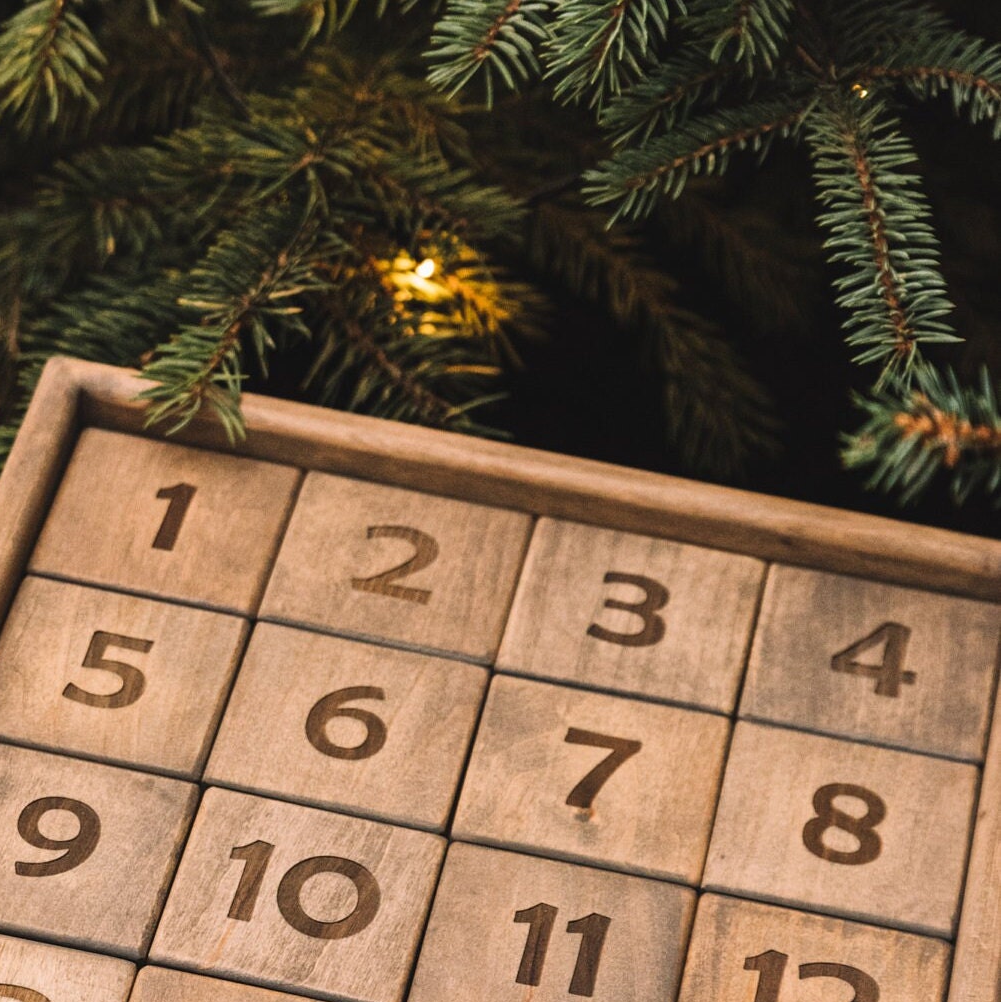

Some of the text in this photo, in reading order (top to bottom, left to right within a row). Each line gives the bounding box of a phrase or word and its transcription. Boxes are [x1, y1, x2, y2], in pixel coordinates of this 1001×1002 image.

[151, 482, 197, 551] 1
[351, 525, 440, 605] 2
[586, 571, 670, 647] 3
[62, 630, 155, 709] 5
[830, 621, 916, 698] 4
[305, 685, 388, 760] 6
[564, 727, 643, 809] 7
[15, 796, 101, 877] 9
[802, 783, 887, 866] 8
[227, 840, 381, 940] 10
[513, 902, 612, 998] 11
